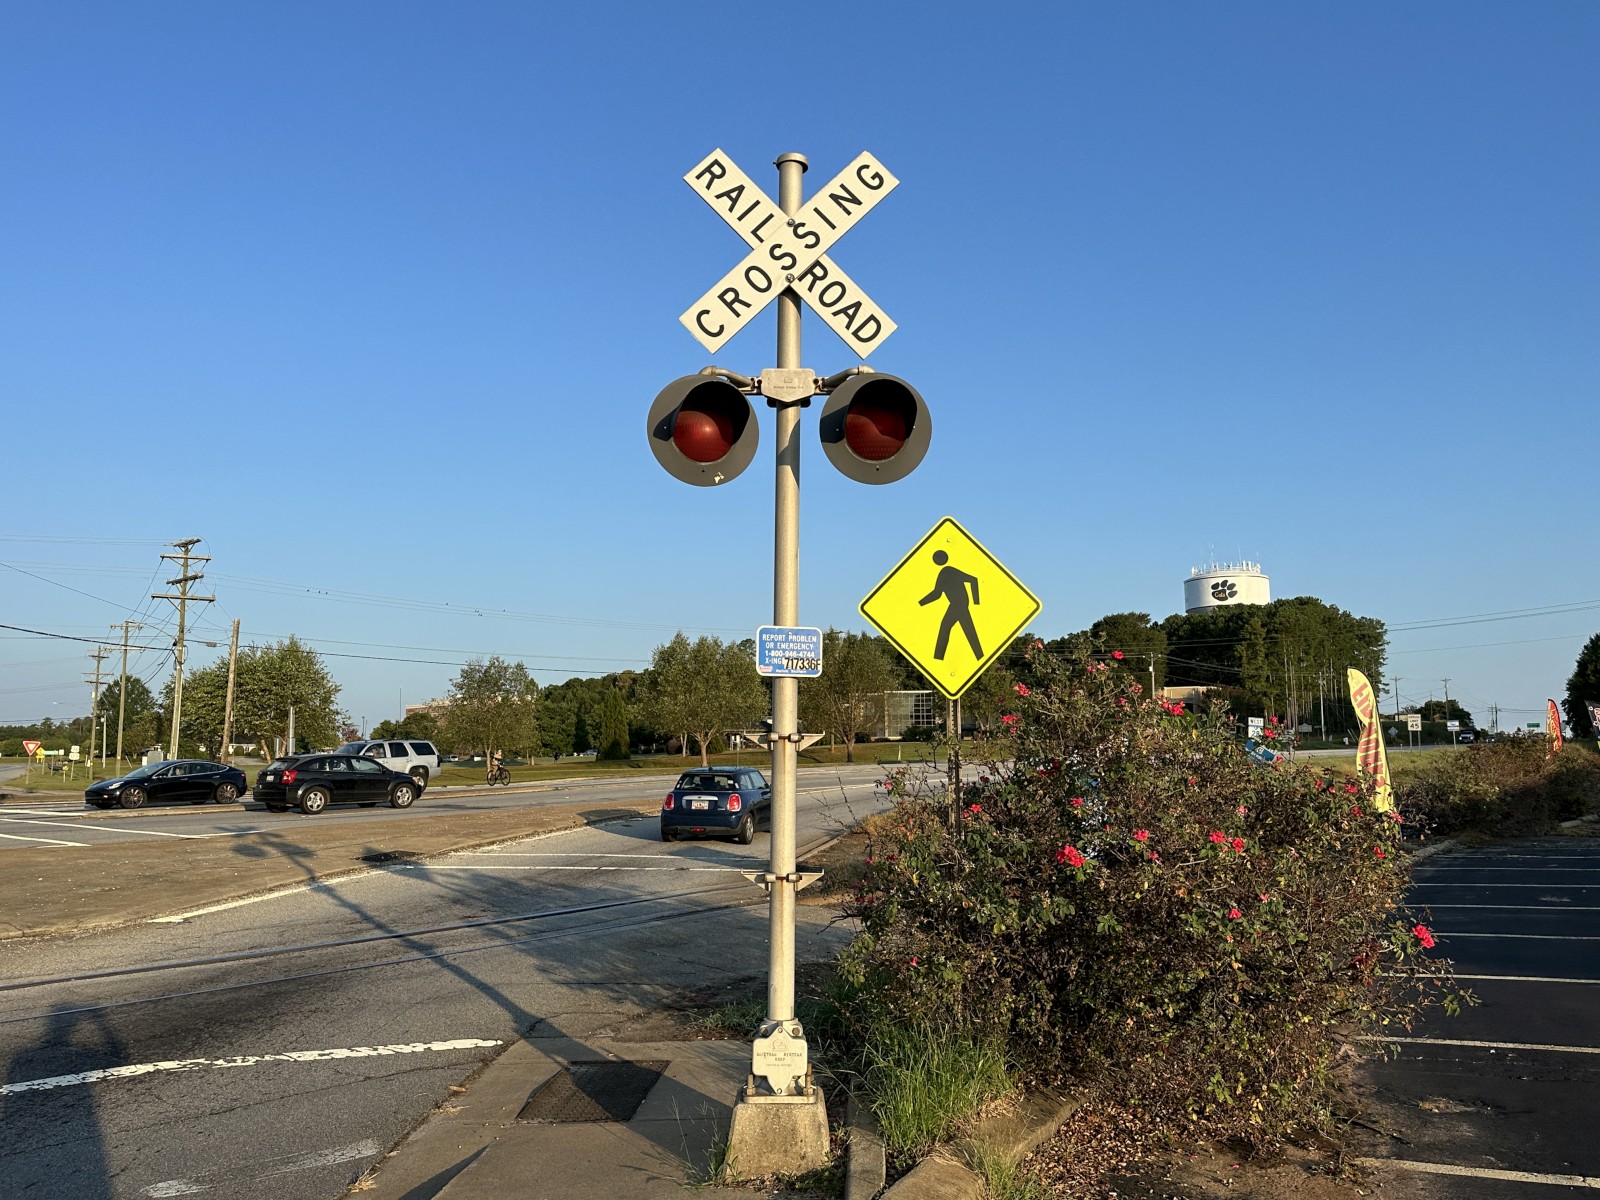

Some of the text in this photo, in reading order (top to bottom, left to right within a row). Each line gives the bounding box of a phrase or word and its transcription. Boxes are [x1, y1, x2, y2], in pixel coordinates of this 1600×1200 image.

[695, 158, 882, 343] RAIL ROAD
[696, 164, 885, 338] CROSSING
[784, 658, 820, 670] 717336F
